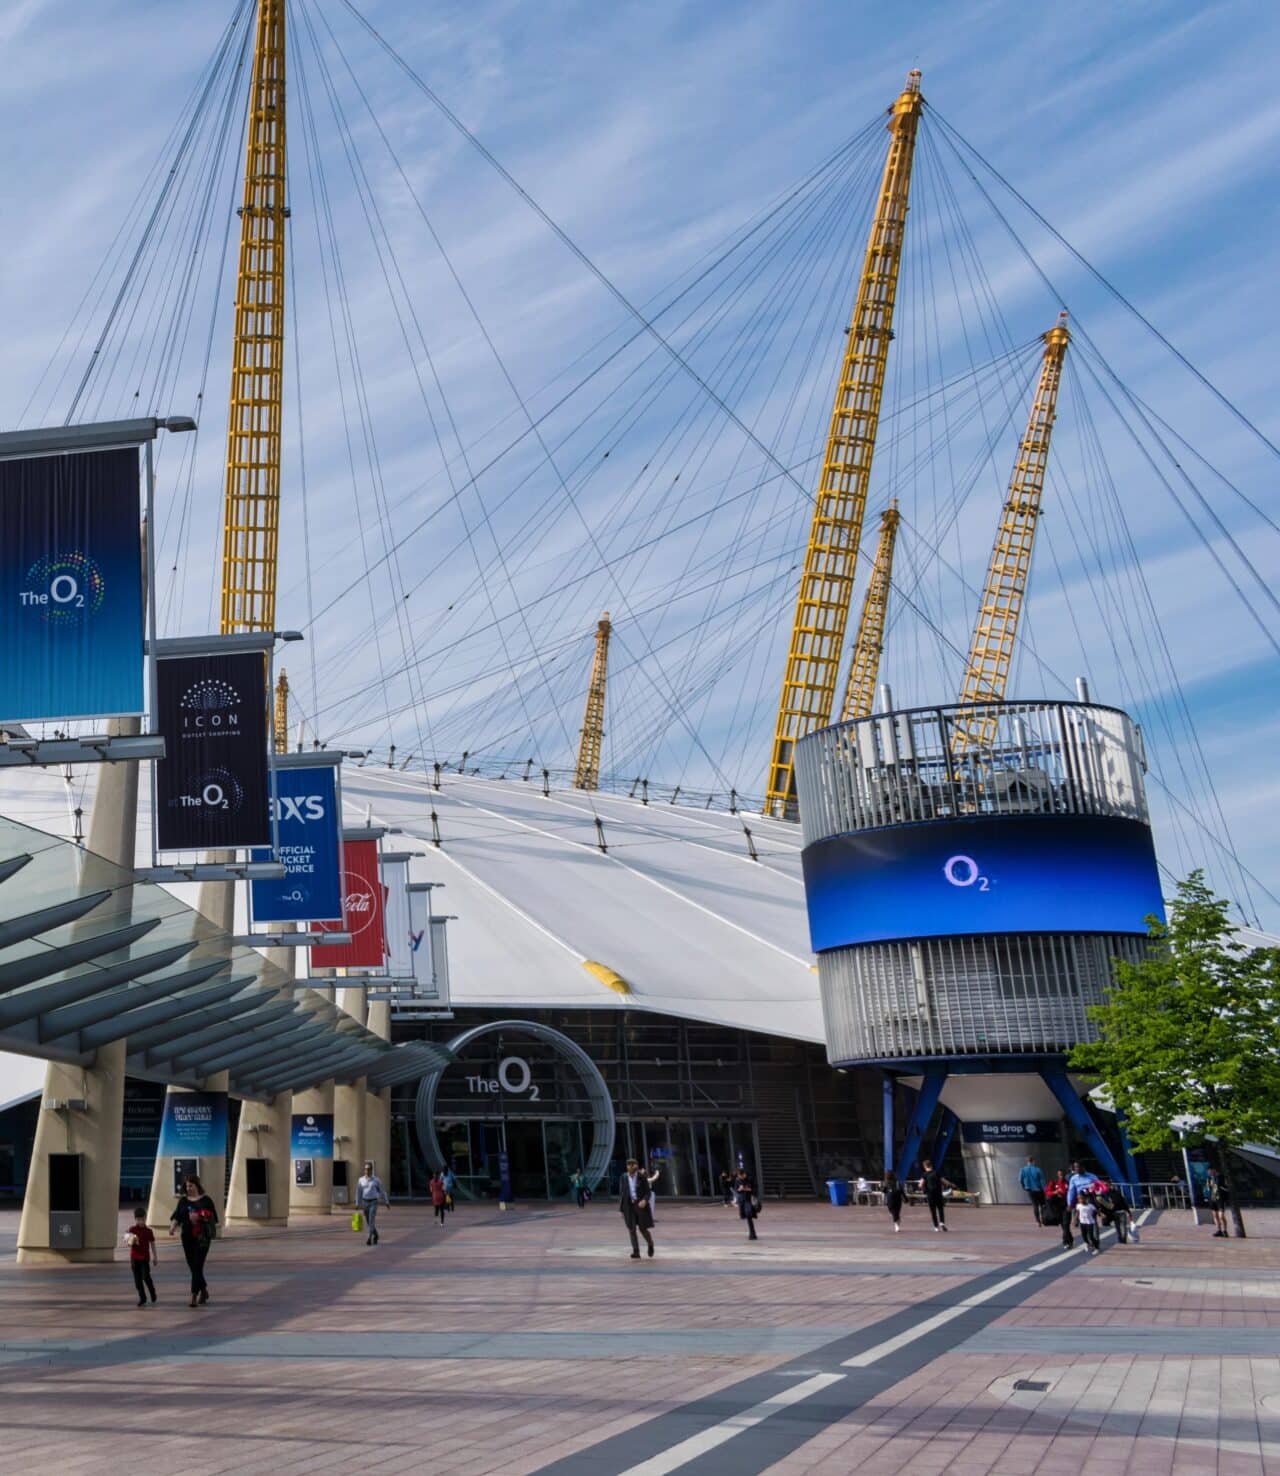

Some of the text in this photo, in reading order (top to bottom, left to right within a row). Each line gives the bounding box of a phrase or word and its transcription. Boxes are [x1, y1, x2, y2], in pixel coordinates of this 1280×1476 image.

[19, 574, 85, 608] The O2
[184, 714, 239, 728] ICON
[209, 730, 241, 738] SHOPPING
[180, 796, 202, 808] The
[203, 784, 229, 809] O2
[284, 864, 315, 874] OURCE
[944, 855, 990, 891] O2
[465, 1056, 541, 1102] The O2
[1001, 1123, 1023, 1133] drop
